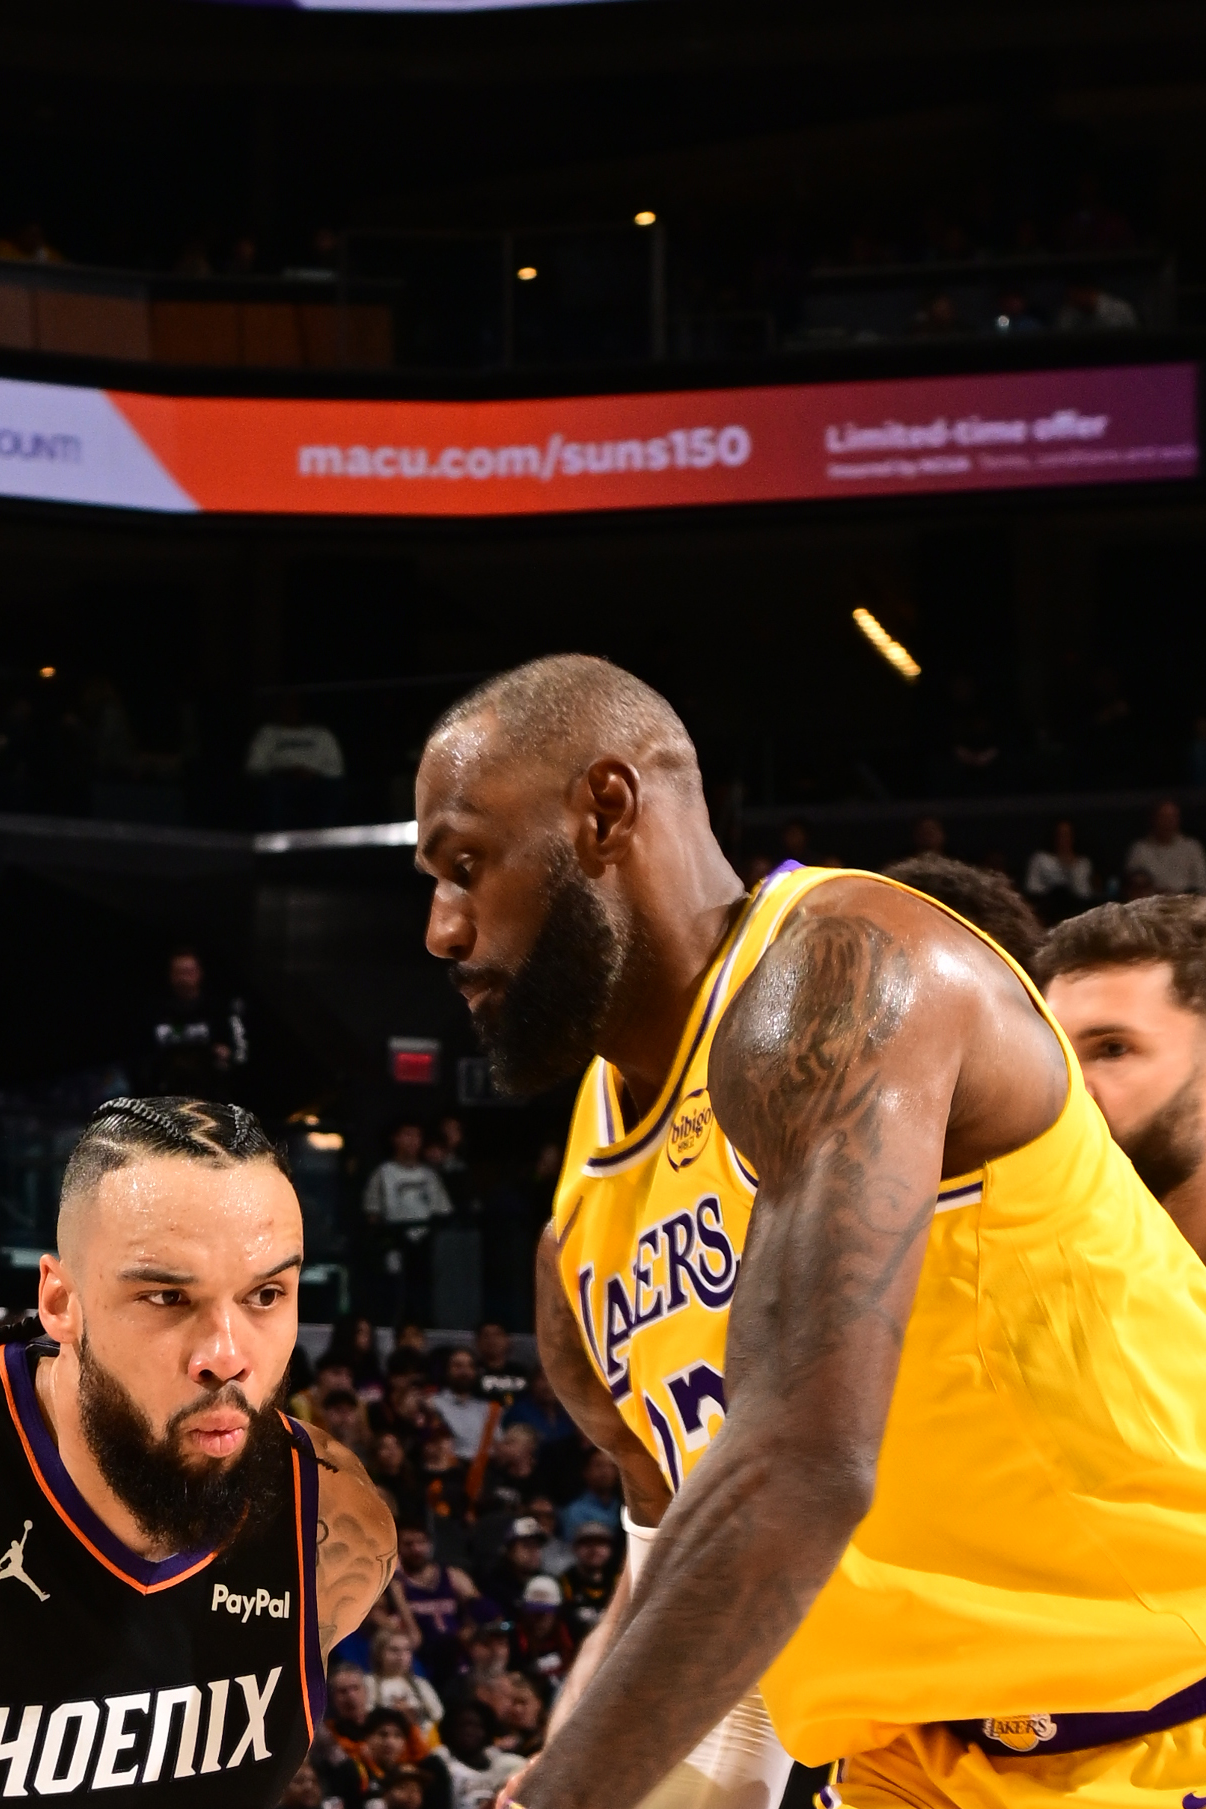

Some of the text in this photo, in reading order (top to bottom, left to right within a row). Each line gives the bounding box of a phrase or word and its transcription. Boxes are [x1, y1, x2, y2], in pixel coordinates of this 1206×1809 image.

[297, 424, 752, 484] macu.com/suns150
[671, 1107, 713, 1145] bibigo
[579, 1193, 741, 1402] LAERS
[210, 1583, 291, 1624] PayPal
[988, 1715, 1052, 1739] LAKERS
